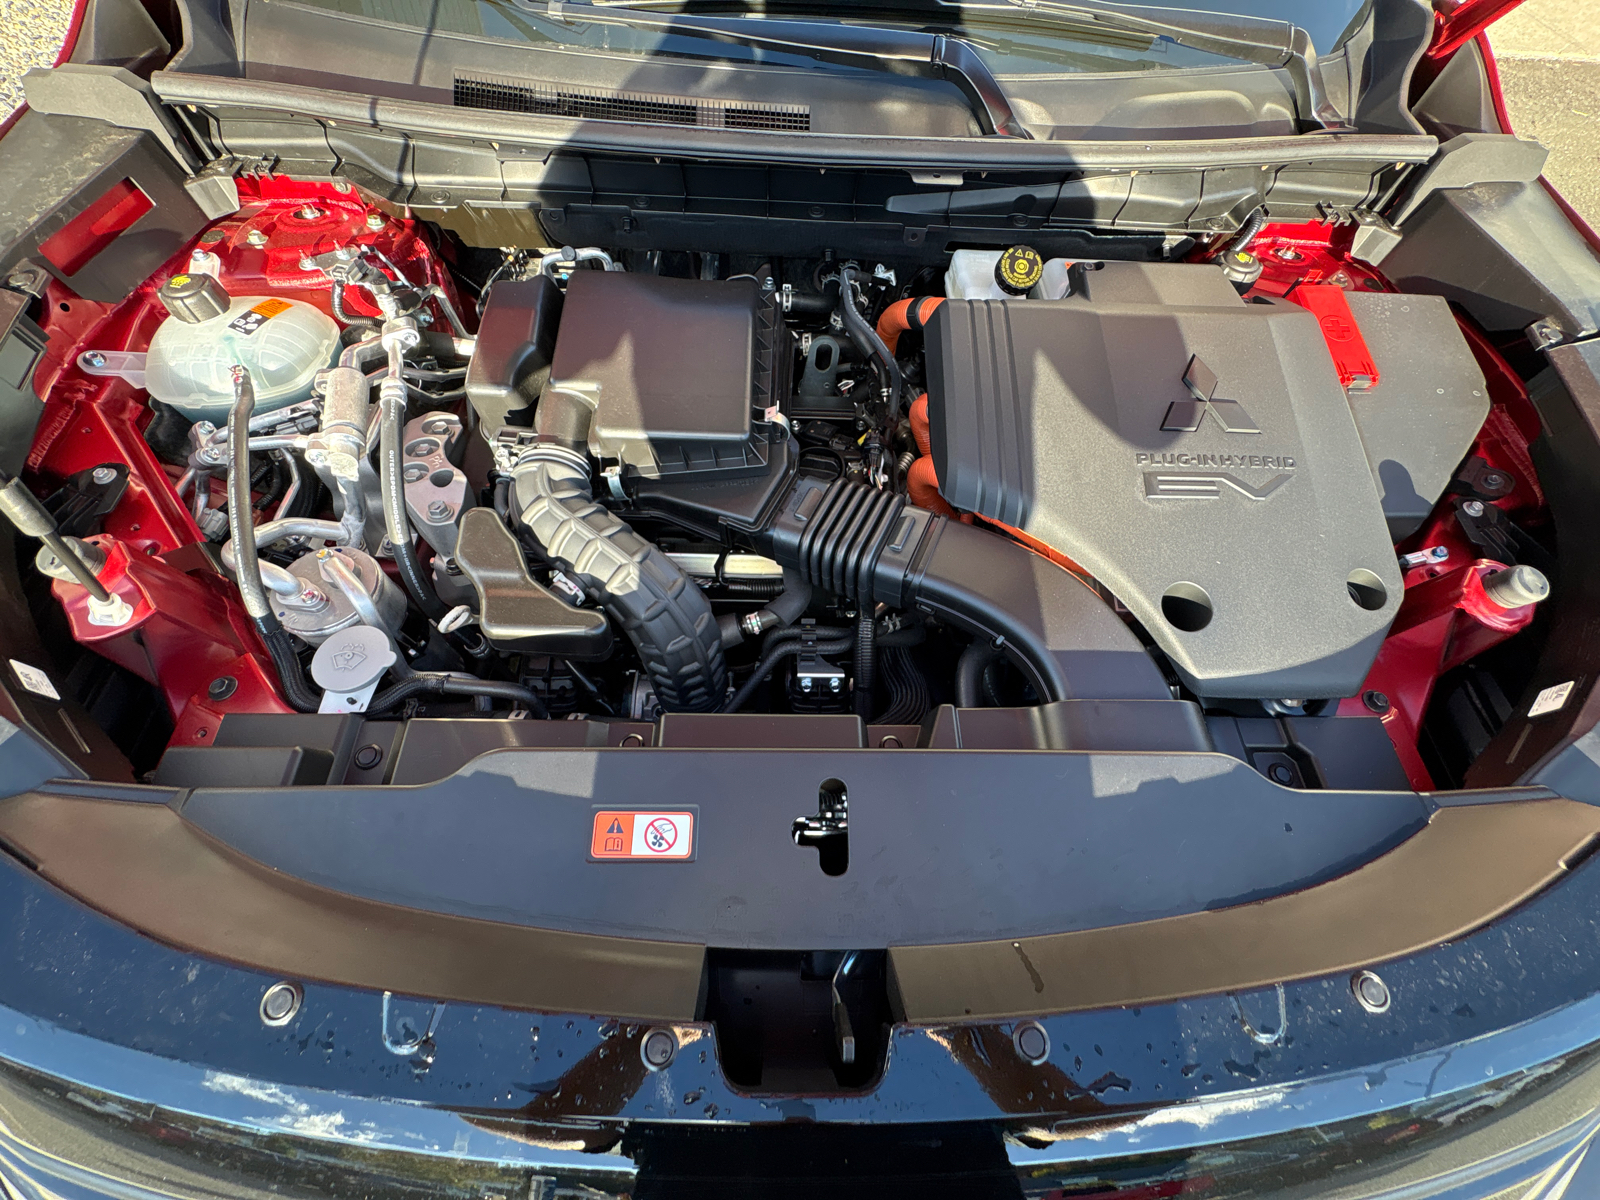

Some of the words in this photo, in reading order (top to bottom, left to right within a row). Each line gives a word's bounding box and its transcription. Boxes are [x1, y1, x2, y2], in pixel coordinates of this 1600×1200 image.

[1135, 452, 1218, 468] PLUG-IN
[1219, 454, 1298, 470] HYBRID
[1142, 470, 1298, 501] EV
